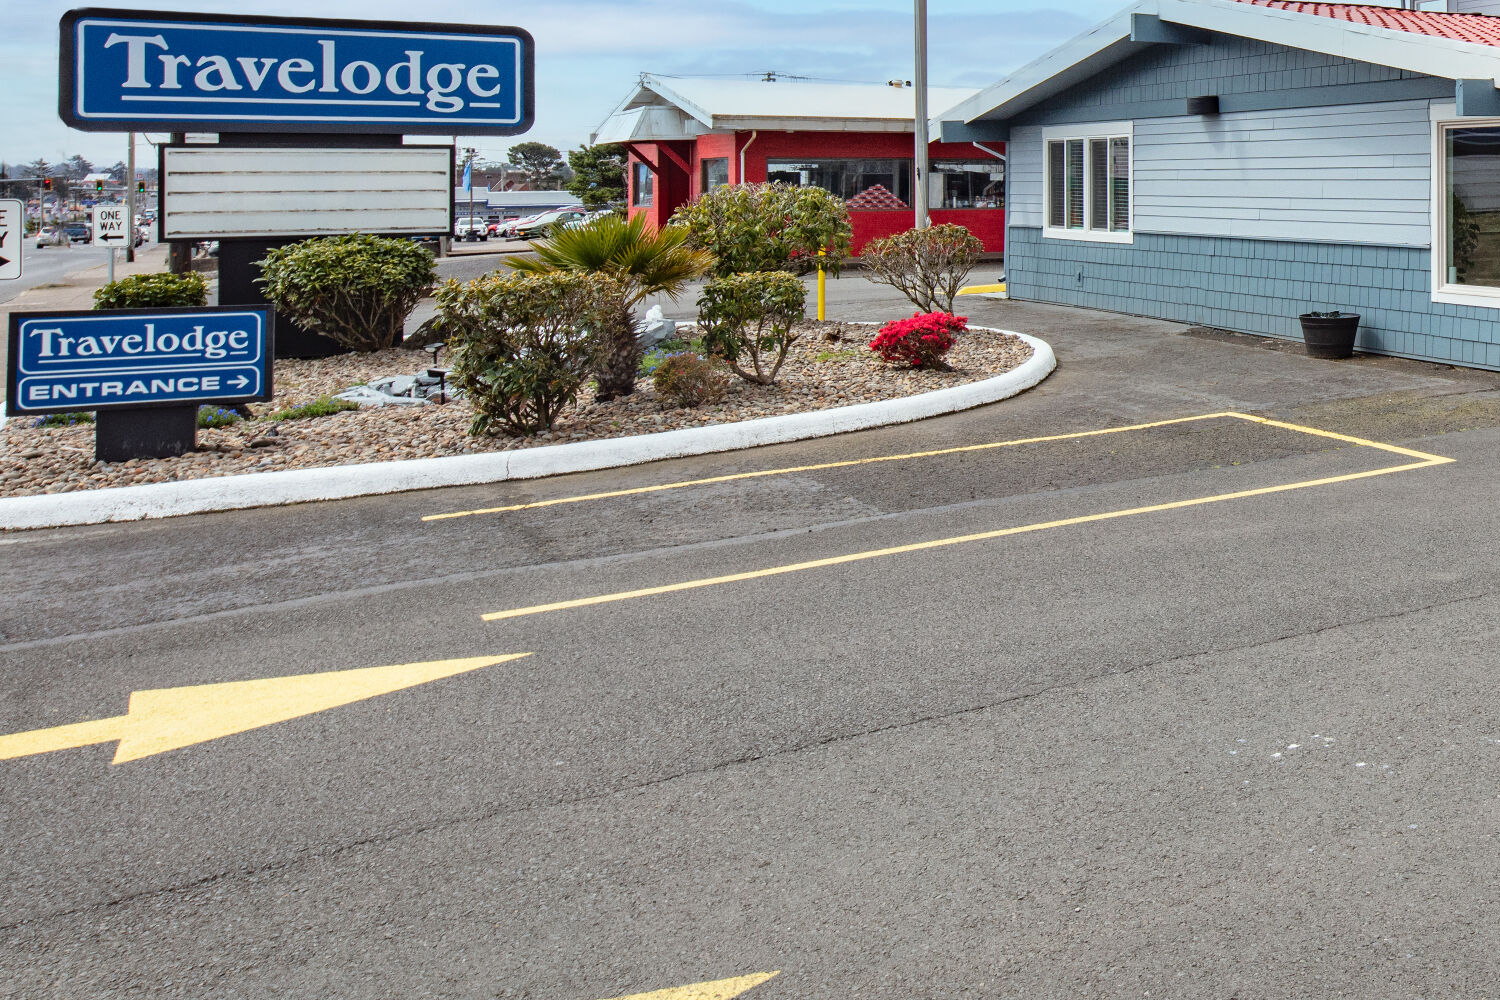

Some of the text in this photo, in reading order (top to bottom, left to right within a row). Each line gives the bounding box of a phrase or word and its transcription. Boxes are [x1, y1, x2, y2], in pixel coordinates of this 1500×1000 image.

[104, 32, 500, 112] Travelodge
[100, 221, 122, 231] WAY
[101, 210, 120, 220] ONE
[29, 323, 249, 359] Travelodge
[29, 376, 220, 400] ENTRANCE
